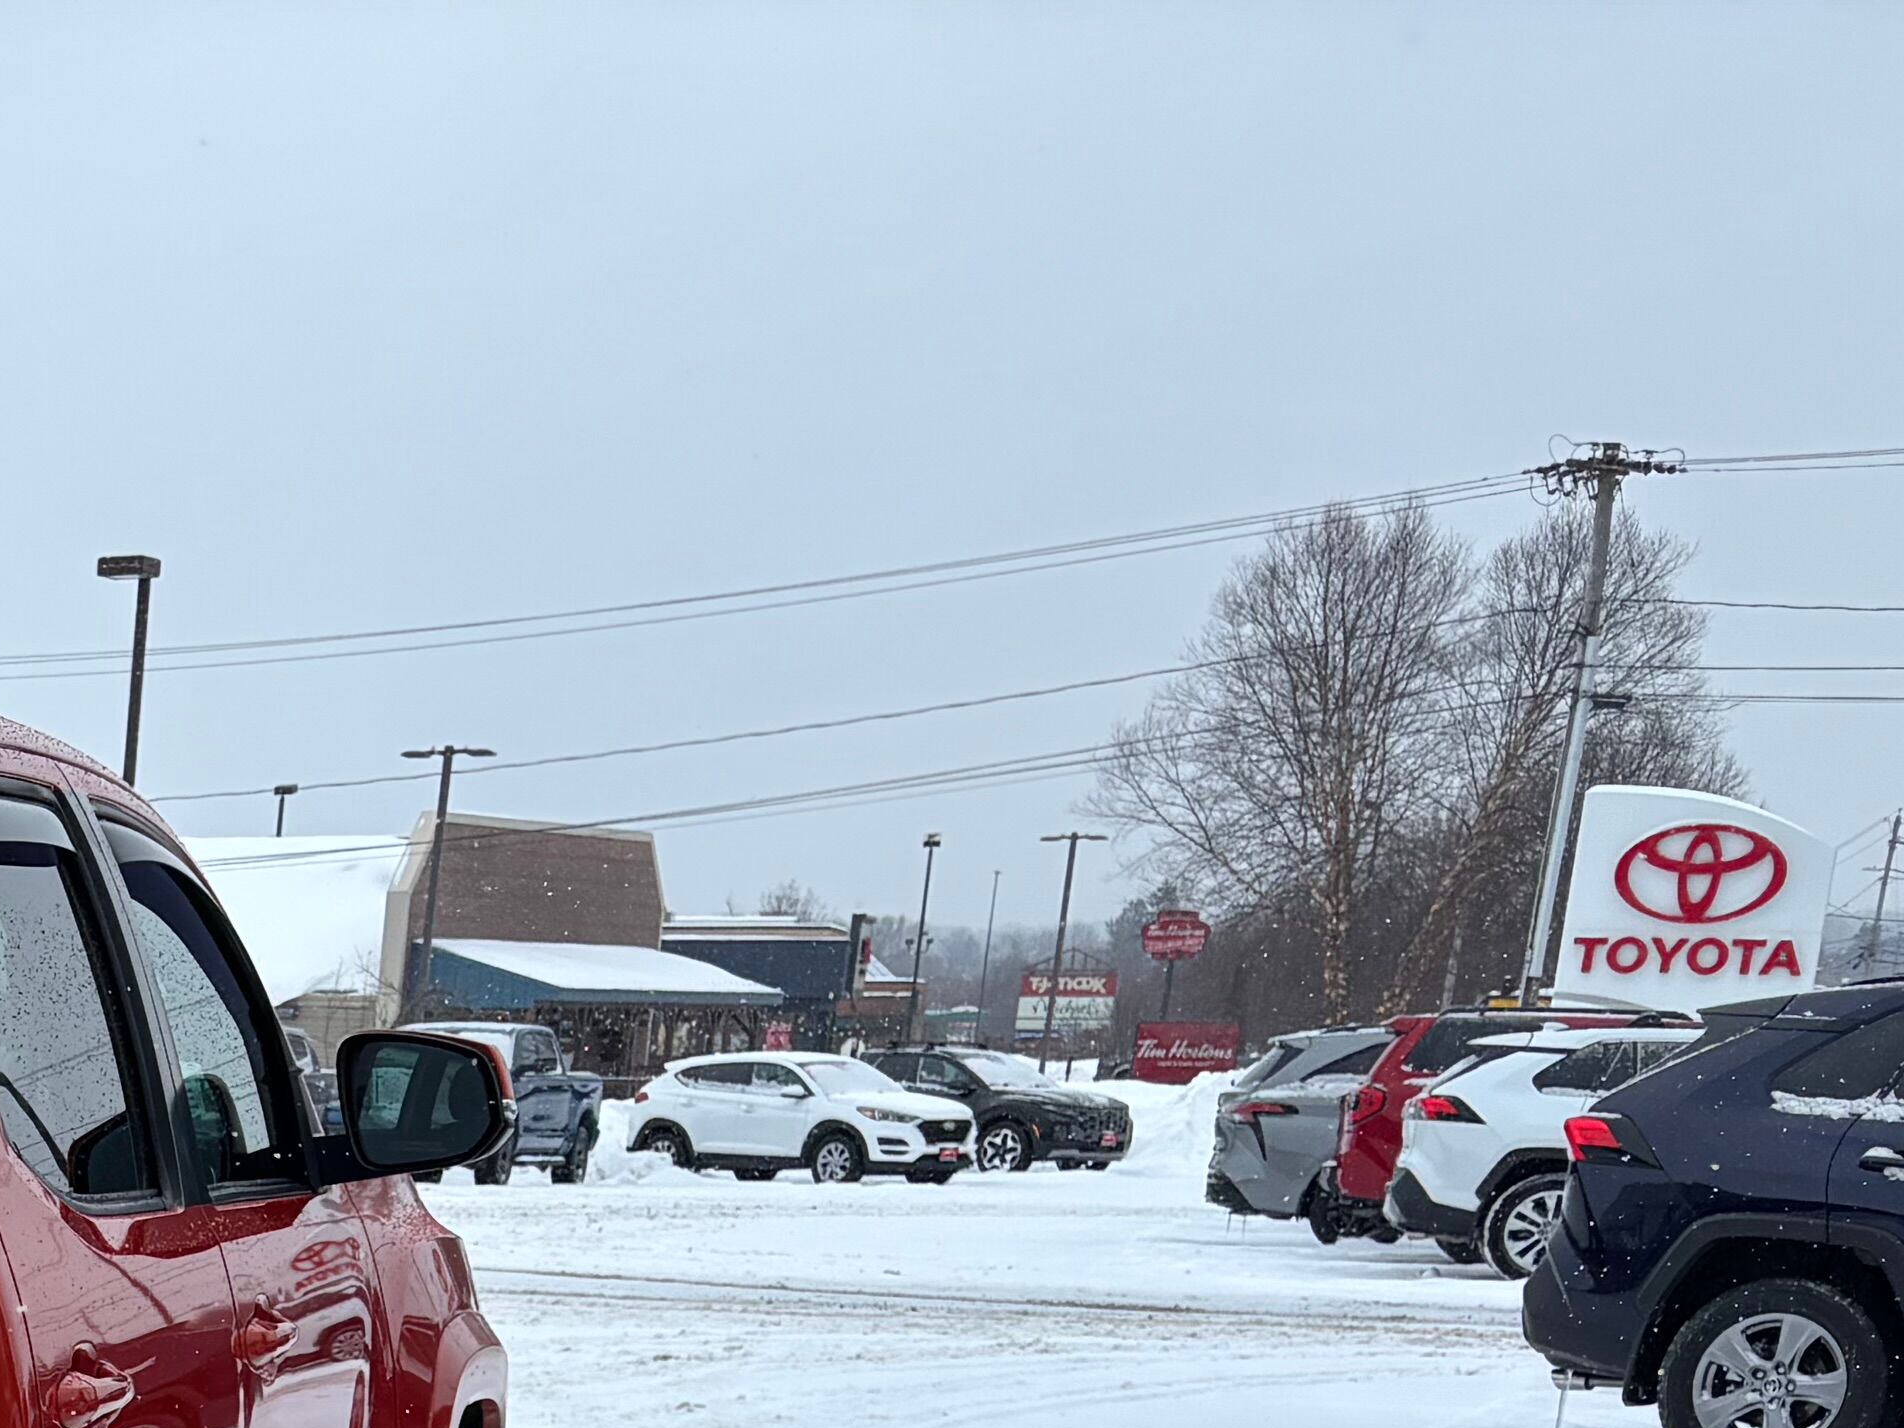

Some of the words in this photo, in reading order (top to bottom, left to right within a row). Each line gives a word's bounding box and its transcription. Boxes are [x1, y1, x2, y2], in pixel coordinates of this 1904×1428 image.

[1574, 936, 1801, 977] TOYOTA
[1137, 1038, 1166, 1059] Tim
[1168, 1039, 1233, 1060] Hortons
